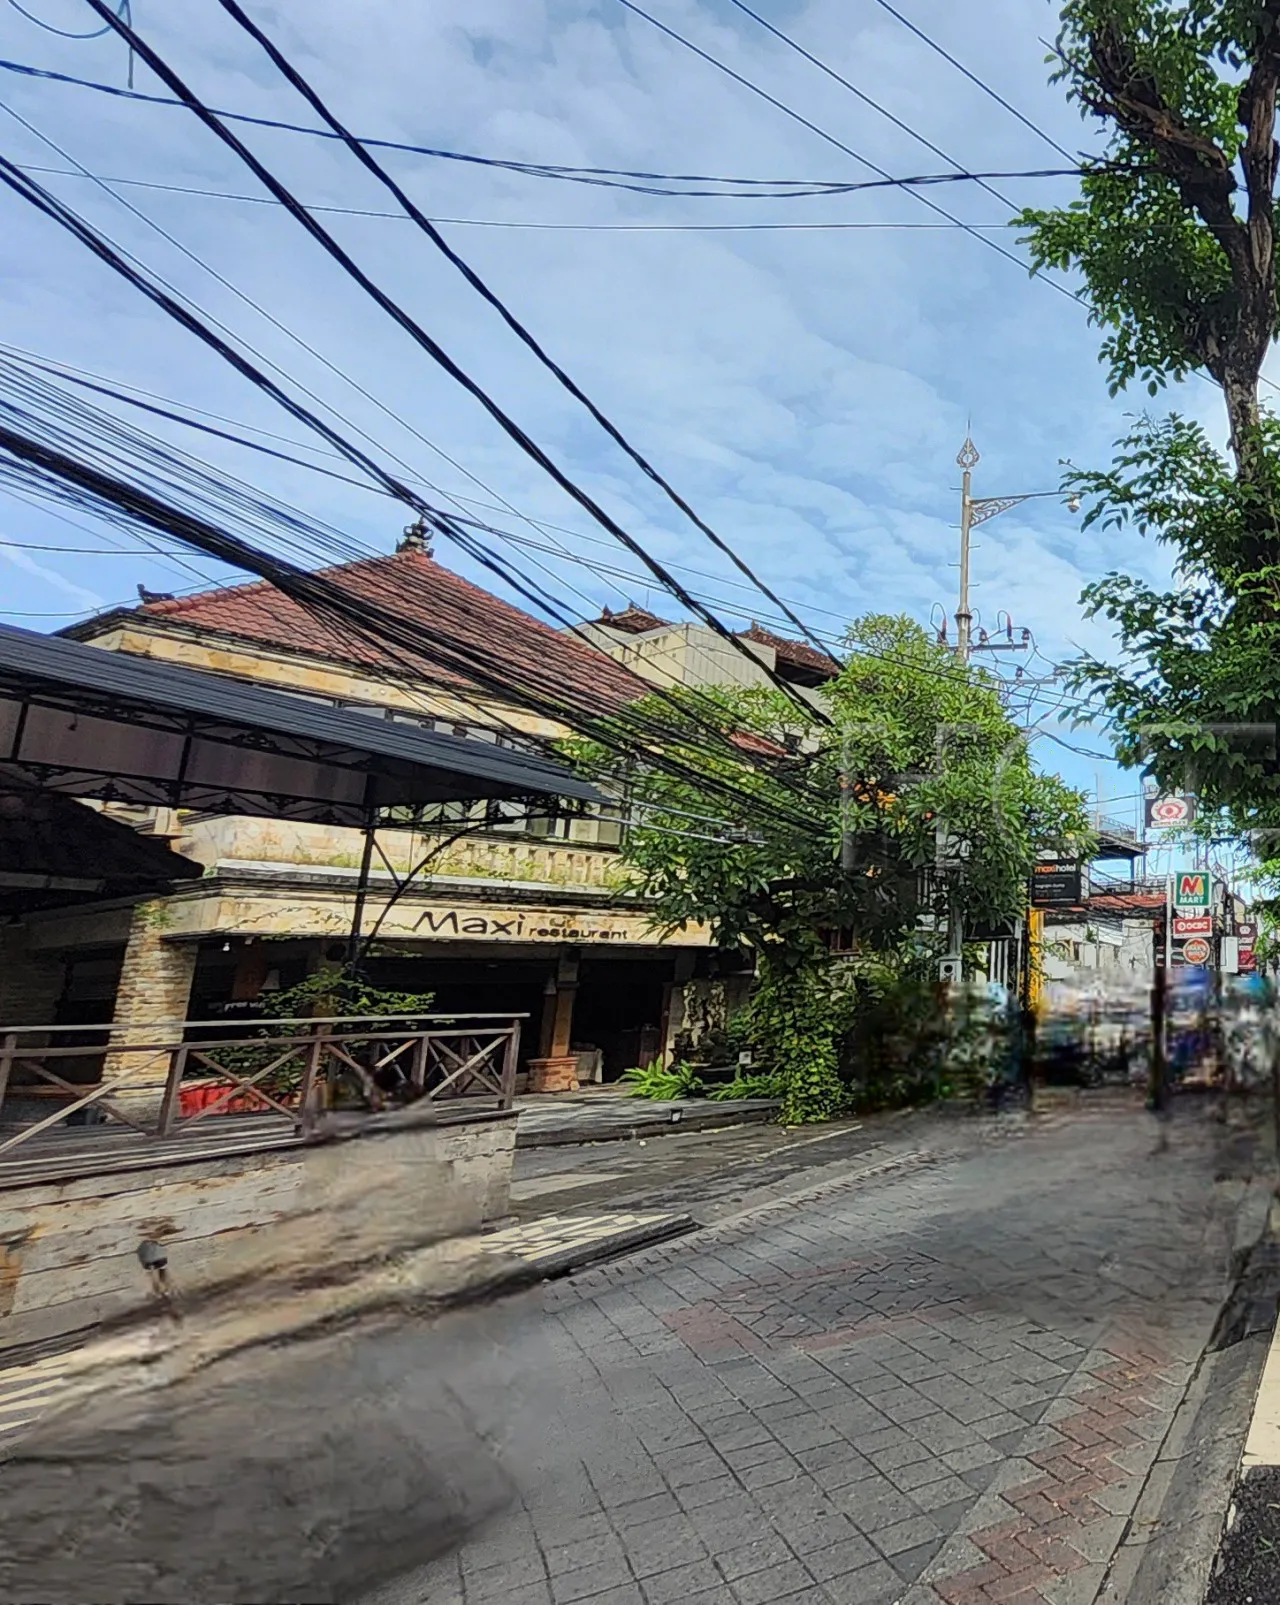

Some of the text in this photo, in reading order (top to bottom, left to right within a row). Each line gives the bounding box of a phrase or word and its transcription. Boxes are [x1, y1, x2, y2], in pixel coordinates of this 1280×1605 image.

[1180, 896, 1204, 904] MART
[414, 911, 628, 939] Maxi restaurant
